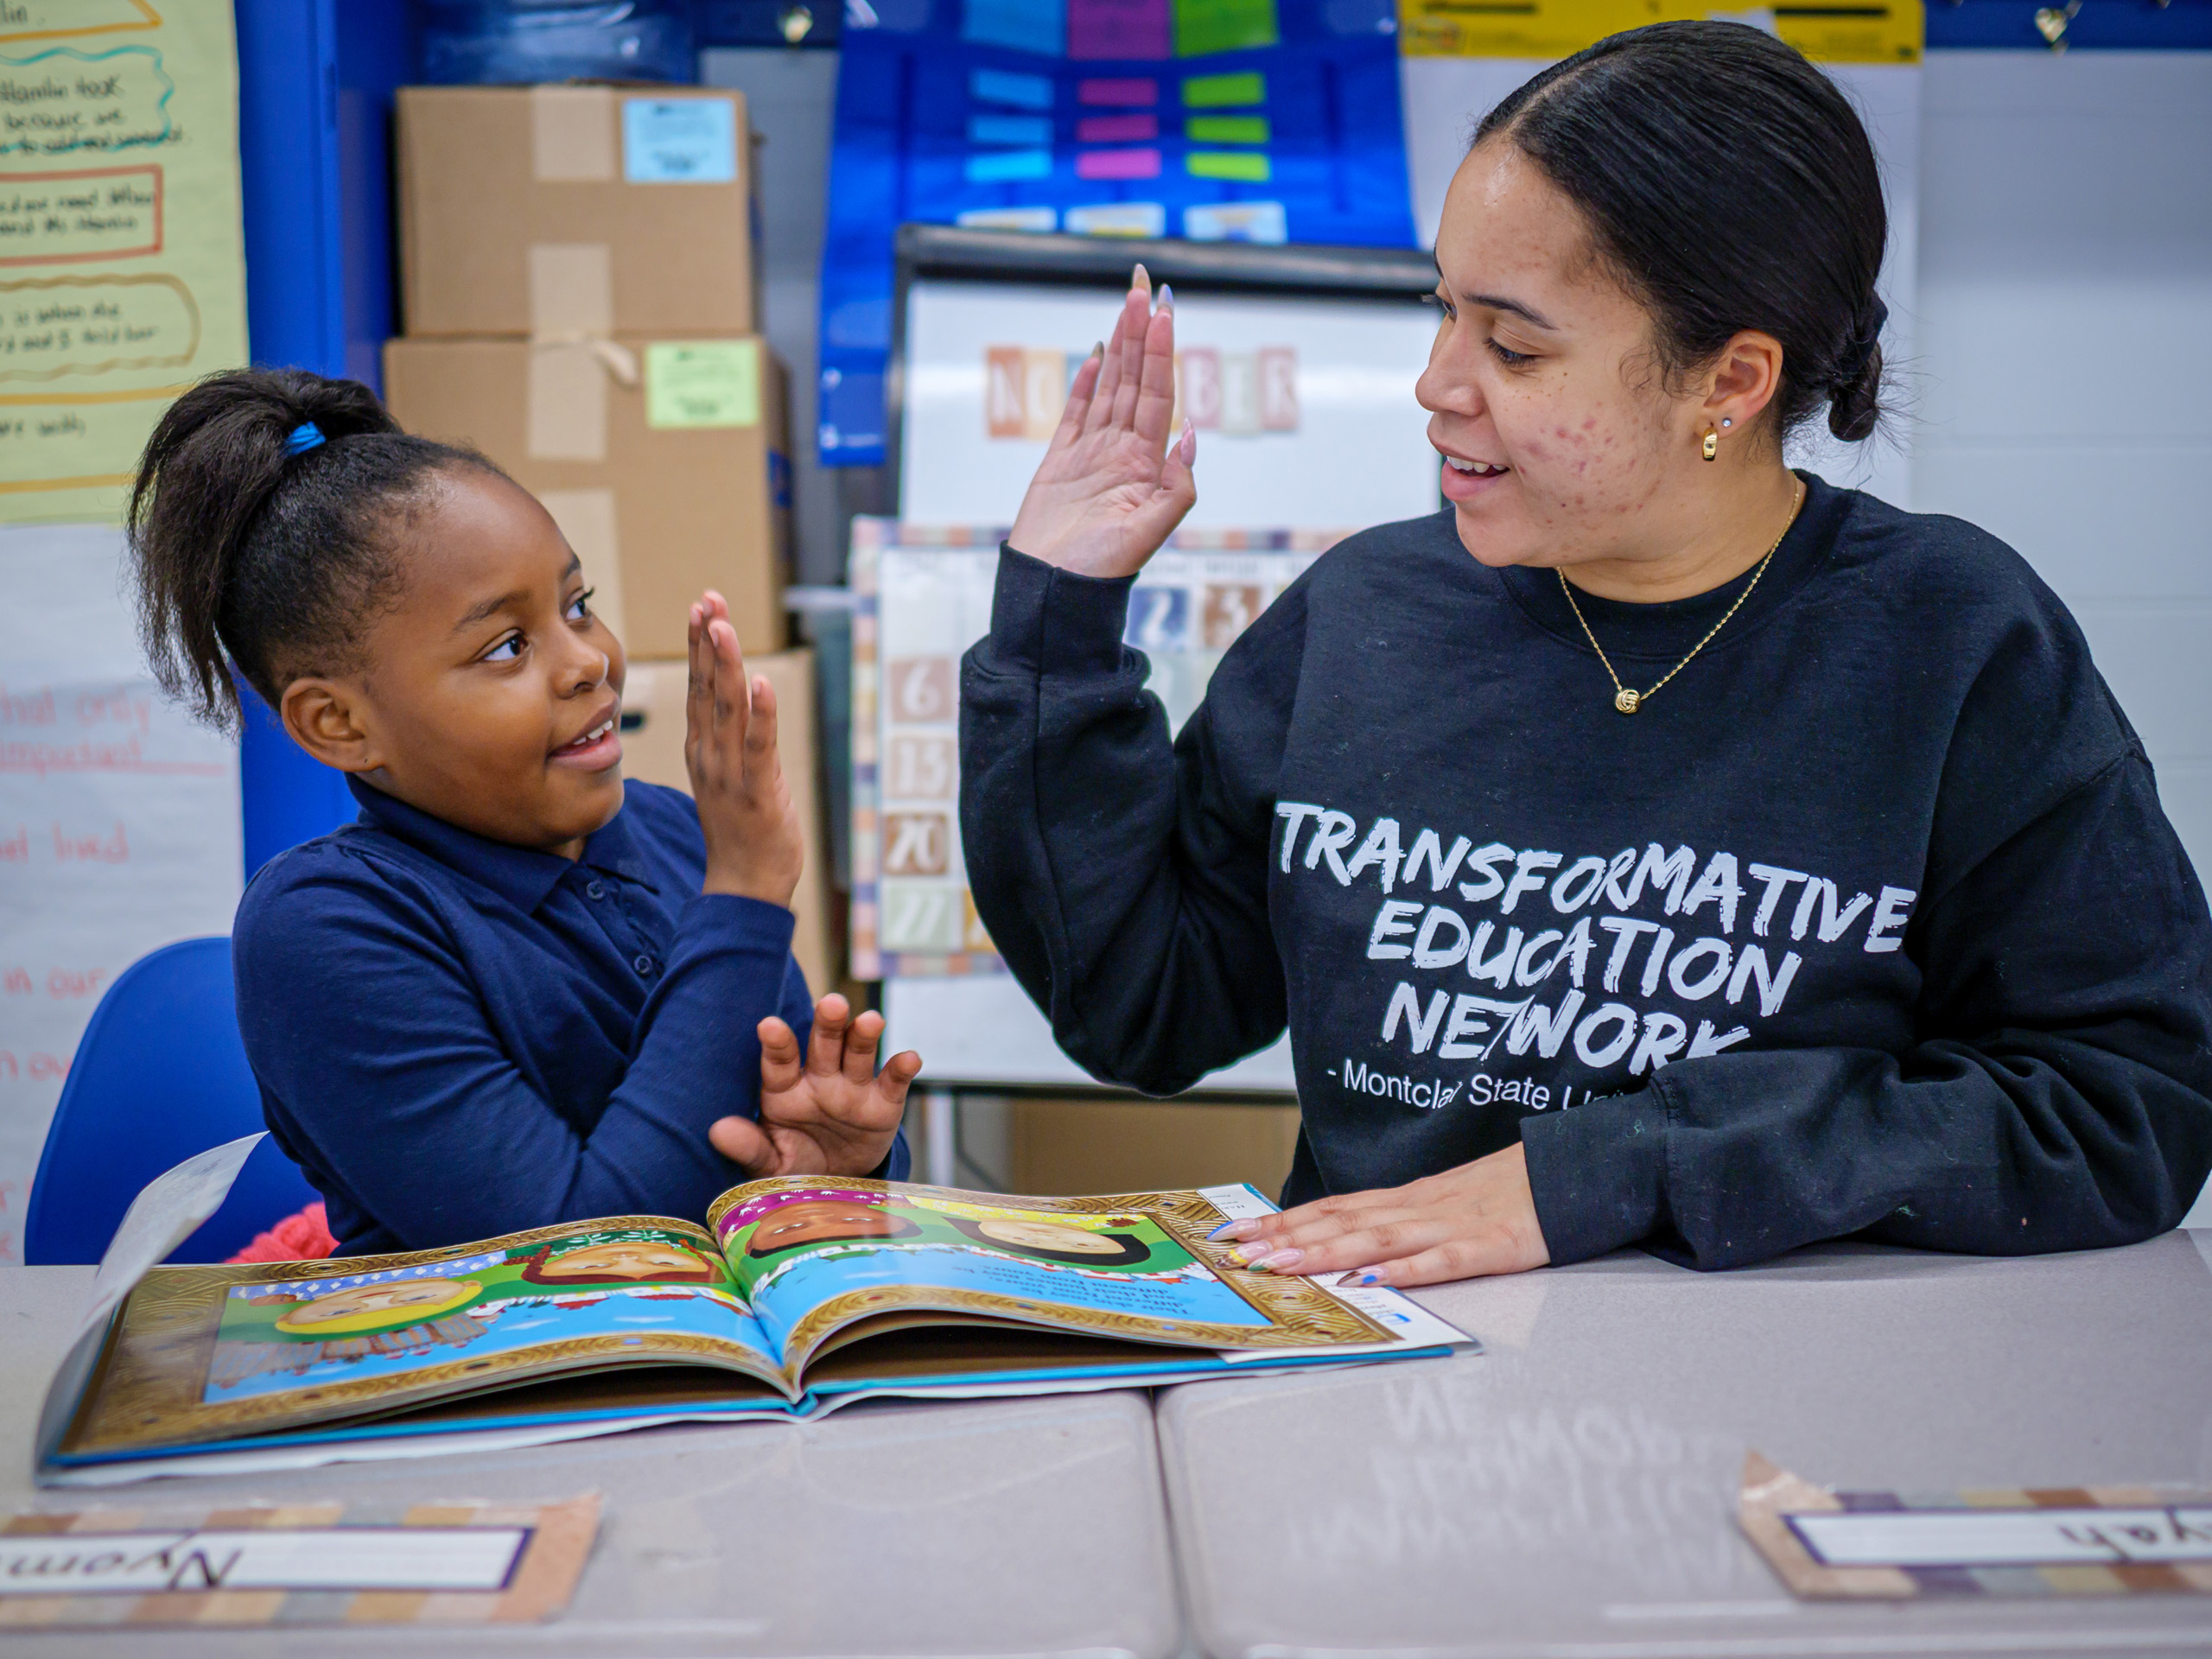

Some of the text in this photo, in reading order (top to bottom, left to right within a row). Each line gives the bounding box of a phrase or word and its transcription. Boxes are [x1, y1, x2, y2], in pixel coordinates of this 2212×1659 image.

[902, 661, 942, 718] 6
[1275, 802, 1916, 953] TRANSFORMATIVE
[1367, 900, 1802, 1017] EDUCATION
[1344, 1059, 1463, 1110] Montclar
[1469, 1073, 1550, 1110] State
